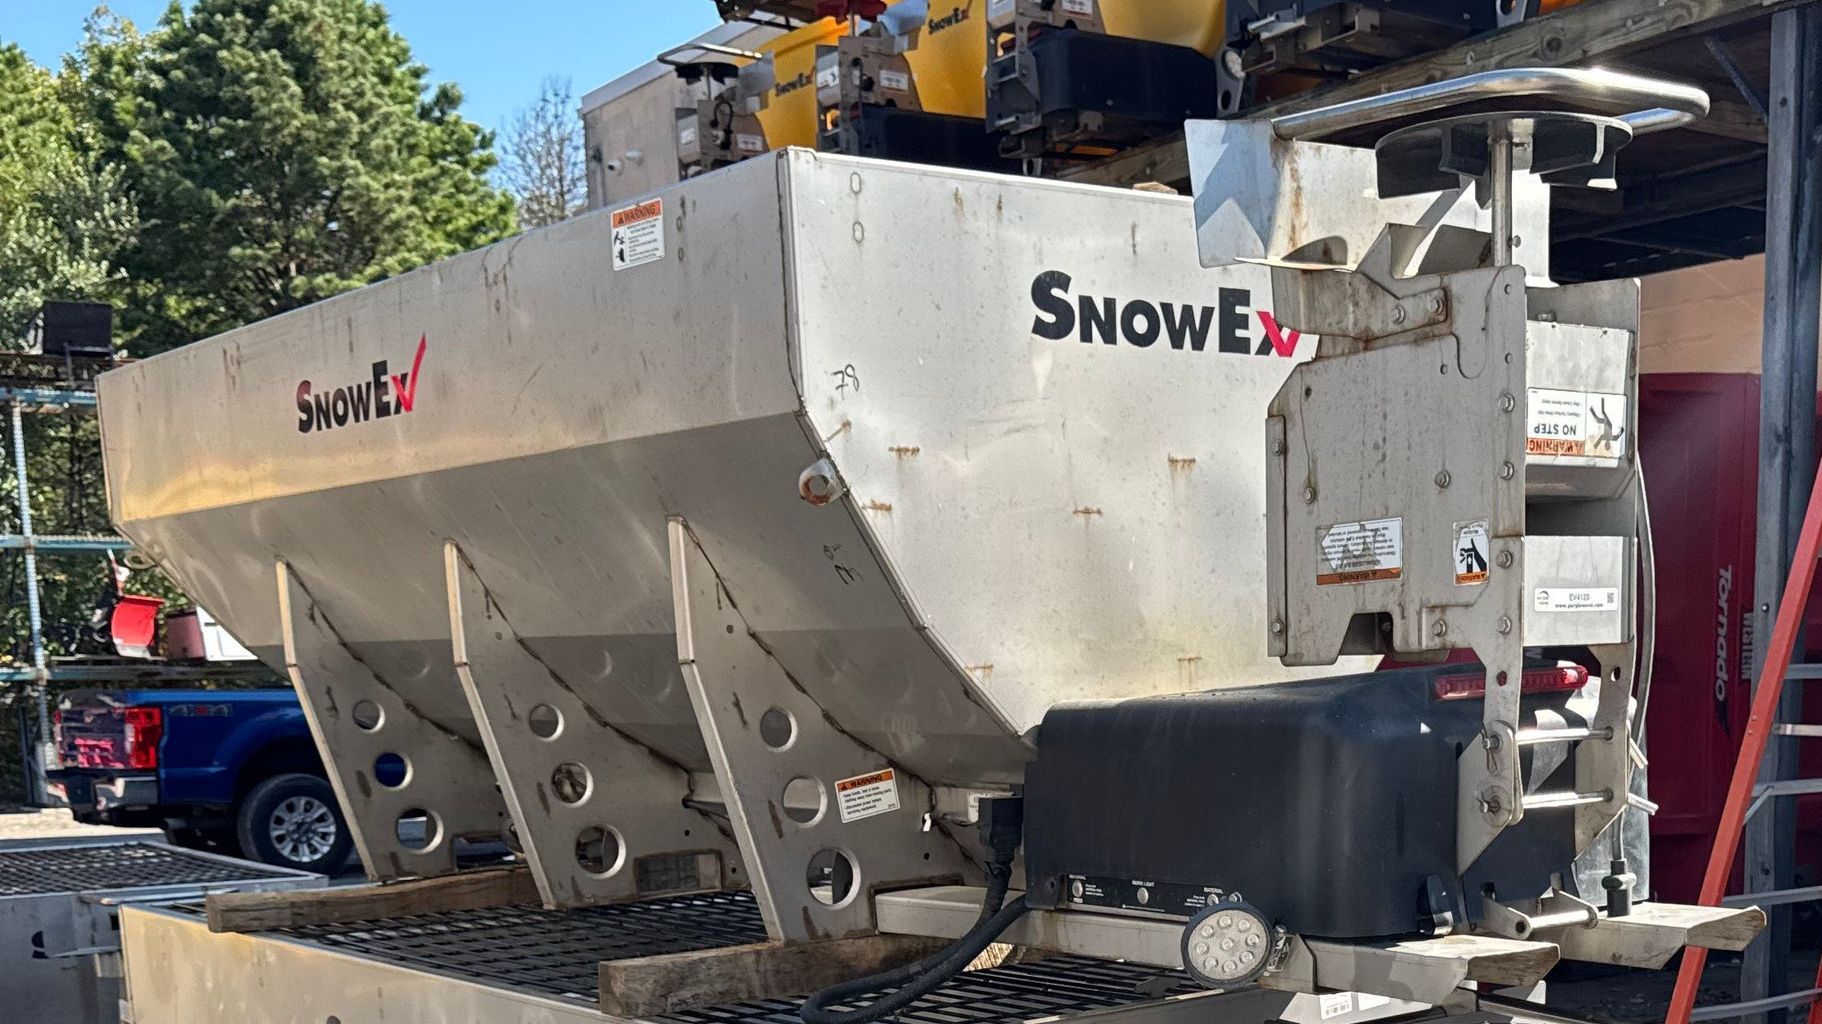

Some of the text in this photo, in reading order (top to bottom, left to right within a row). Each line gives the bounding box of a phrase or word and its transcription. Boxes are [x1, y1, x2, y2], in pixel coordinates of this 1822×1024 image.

[1534, 424, 1577, 436] NO STEP
[1529, 440, 1573, 453] WARNING
[1715, 565, 1732, 700] Tornado
